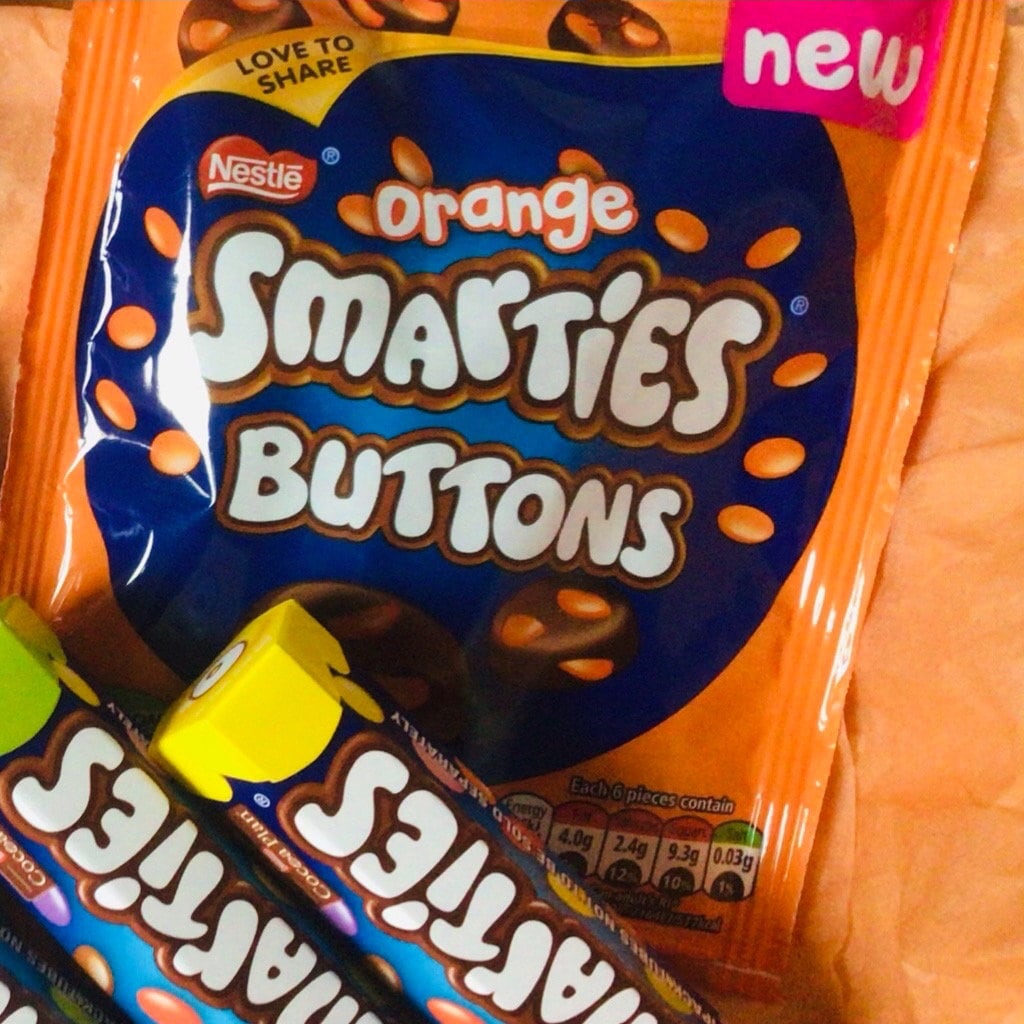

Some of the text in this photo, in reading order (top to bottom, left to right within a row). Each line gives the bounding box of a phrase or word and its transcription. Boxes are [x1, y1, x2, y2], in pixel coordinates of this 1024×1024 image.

[235, 35, 355, 76] LOVE TO
[257, 56, 353, 95] SHARE
[743, 27, 924, 106] new
[377, 179, 633, 251] orange
[189, 230, 763, 436] SMARTIES
[228, 426, 682, 578] BUTTONS
[391, 711, 488, 808] SEPARATELY
[571, 777, 609, 797] Each
[627, 787, 676, 807] pieces
[680, 796, 735, 814] contain
[240, 810, 279, 848] Plan
[492, 805, 533, 852] SOLD
[558, 828, 594, 852] 4.0g
[613, 834, 648, 860] 2.4g
[278, 848, 332, 900] Cocoa
[668, 843, 700, 867] 9.3g
[713, 847, 755, 874] 0.03g
